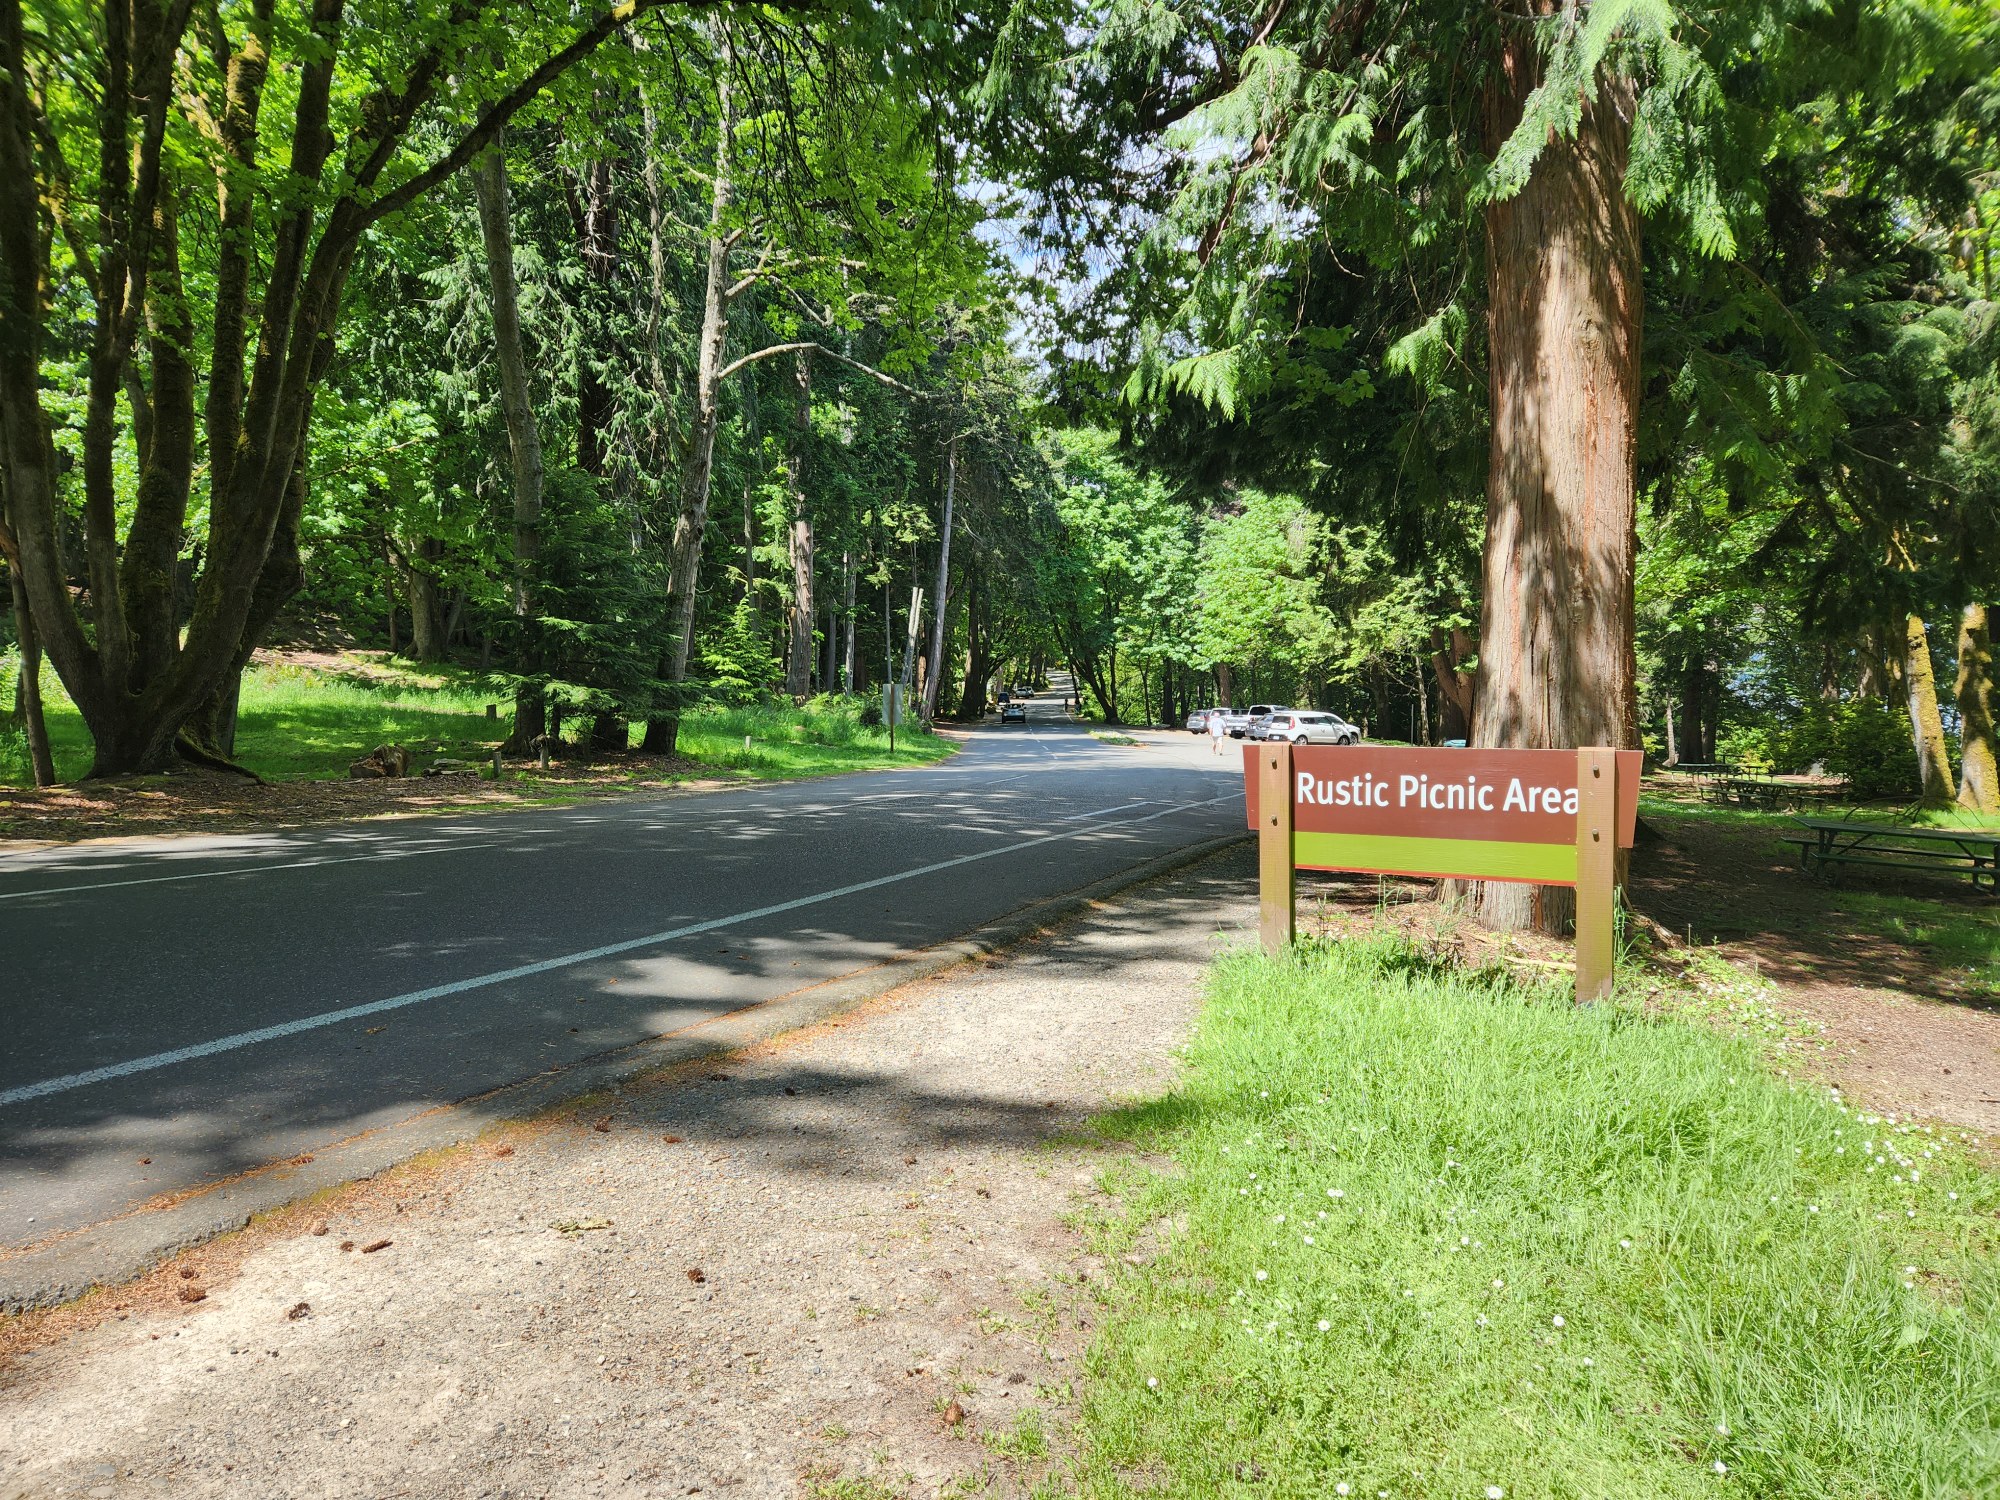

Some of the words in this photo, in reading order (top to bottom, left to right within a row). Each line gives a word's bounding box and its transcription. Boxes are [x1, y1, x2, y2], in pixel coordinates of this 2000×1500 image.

[1297, 772, 1389, 807] Rustic
[1399, 774, 1494, 811] Picnic
[1502, 778, 1579, 815] Area
